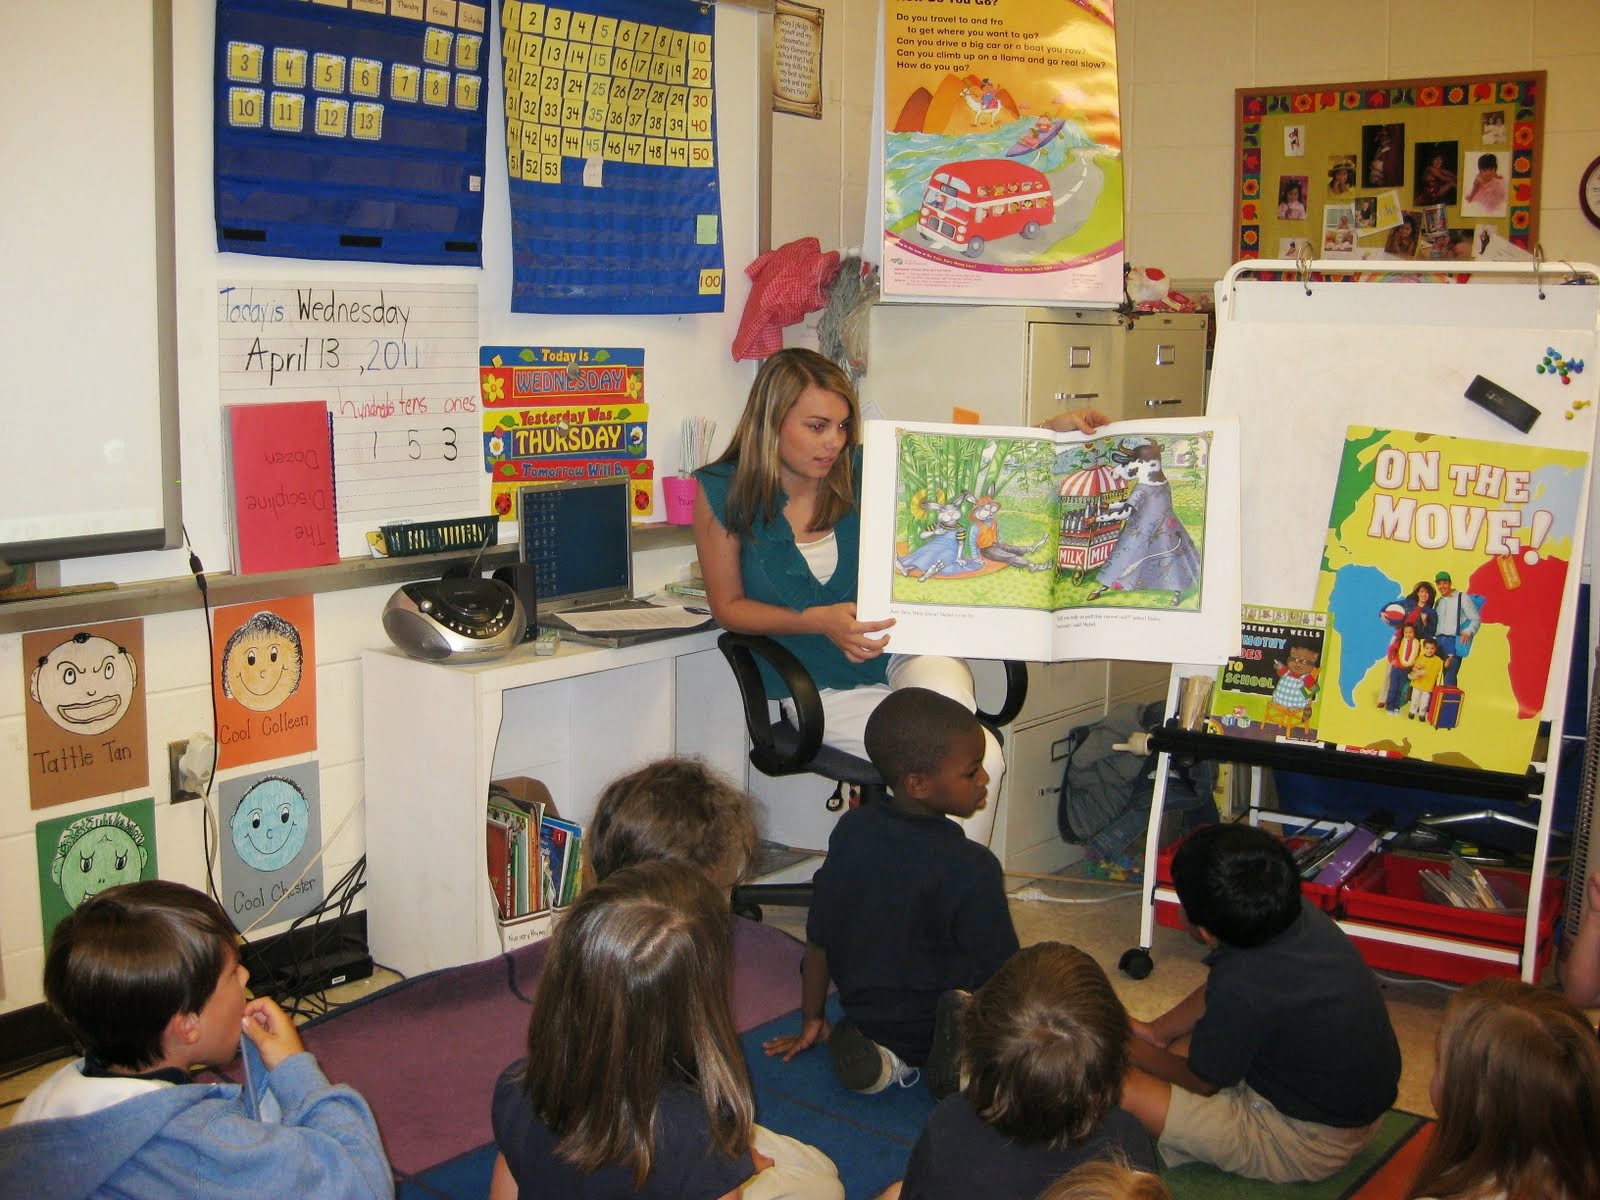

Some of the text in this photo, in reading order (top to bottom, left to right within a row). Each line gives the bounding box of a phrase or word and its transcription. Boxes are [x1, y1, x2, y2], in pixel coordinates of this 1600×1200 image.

[397, 1, 419, 13] Thursday
[433, 7, 448, 17] Friday
[528, 12, 536, 26] 2
[553, 17, 561, 30] 3
[578, 21, 586, 34] 4
[601, 25, 609, 37] 5
[623, 30, 630, 42] 6
[641, 32, 649, 45] 7
[660, 35, 666, 47] 8
[677, 38, 683, 52] 9
[693, 40, 706, 54] 10
[465, 45, 471, 60] 2
[508, 37, 707, 80] 11 12 13 14 15 16 17 18 19 20
[970, 41, 983, 49] big
[1024, 44, 1044, 52] boat
[1000, 54, 1025, 62] llama
[240, 54, 471, 100] 3 4 5 6 7 8 9
[897, 61, 917, 69] How
[953, 64, 969, 72] go?
[508, 68, 708, 107] 21 22 23 24 25 26 27 28 29 30
[238, 98, 373, 130] 10 11 12 13
[509, 97, 707, 132] 31 32 33 34 35 36 37 38 39 40
[510, 127, 709, 161] 41 42 43 44 45 46 47 48 49 50
[511, 156, 558, 176] 51 52 53
[700, 275, 720, 288] 100
[220, 287, 410, 343] Today is Wednesday
[245, 337, 308, 386] April
[320, 338, 340, 369] 13
[542, 349, 589, 363] Today Is
[516, 369, 624, 393] WEDNESDAY
[399, 387, 427, 415] tens
[444, 396, 476, 413] ones
[520, 408, 612, 426] Yesterday Was
[374, 427, 457, 461] 1 5 3
[516, 425, 621, 454] THURSDAY
[264, 450, 320, 470] Dozen
[522, 462, 628, 477] Tomorrow Will Be
[1373, 448, 1530, 503] ON THE
[246, 484, 325, 520] Discipline
[296, 524, 325, 547] The
[1367, 494, 1554, 566] MOVE!
[1060, 550, 1084, 564] MILK
[1241, 624, 1284, 634] OSEMARY
[1241, 648, 1262, 660] OES
[1242, 635, 1287, 649] MOTHY
[1228, 660, 1243, 672] TO
[1225, 672, 1275, 689] SCHOOL
[220, 712, 308, 744] Cool Colleen
[34, 740, 132, 774] Tattle Tan
[234, 879, 315, 913] Cool Chester
